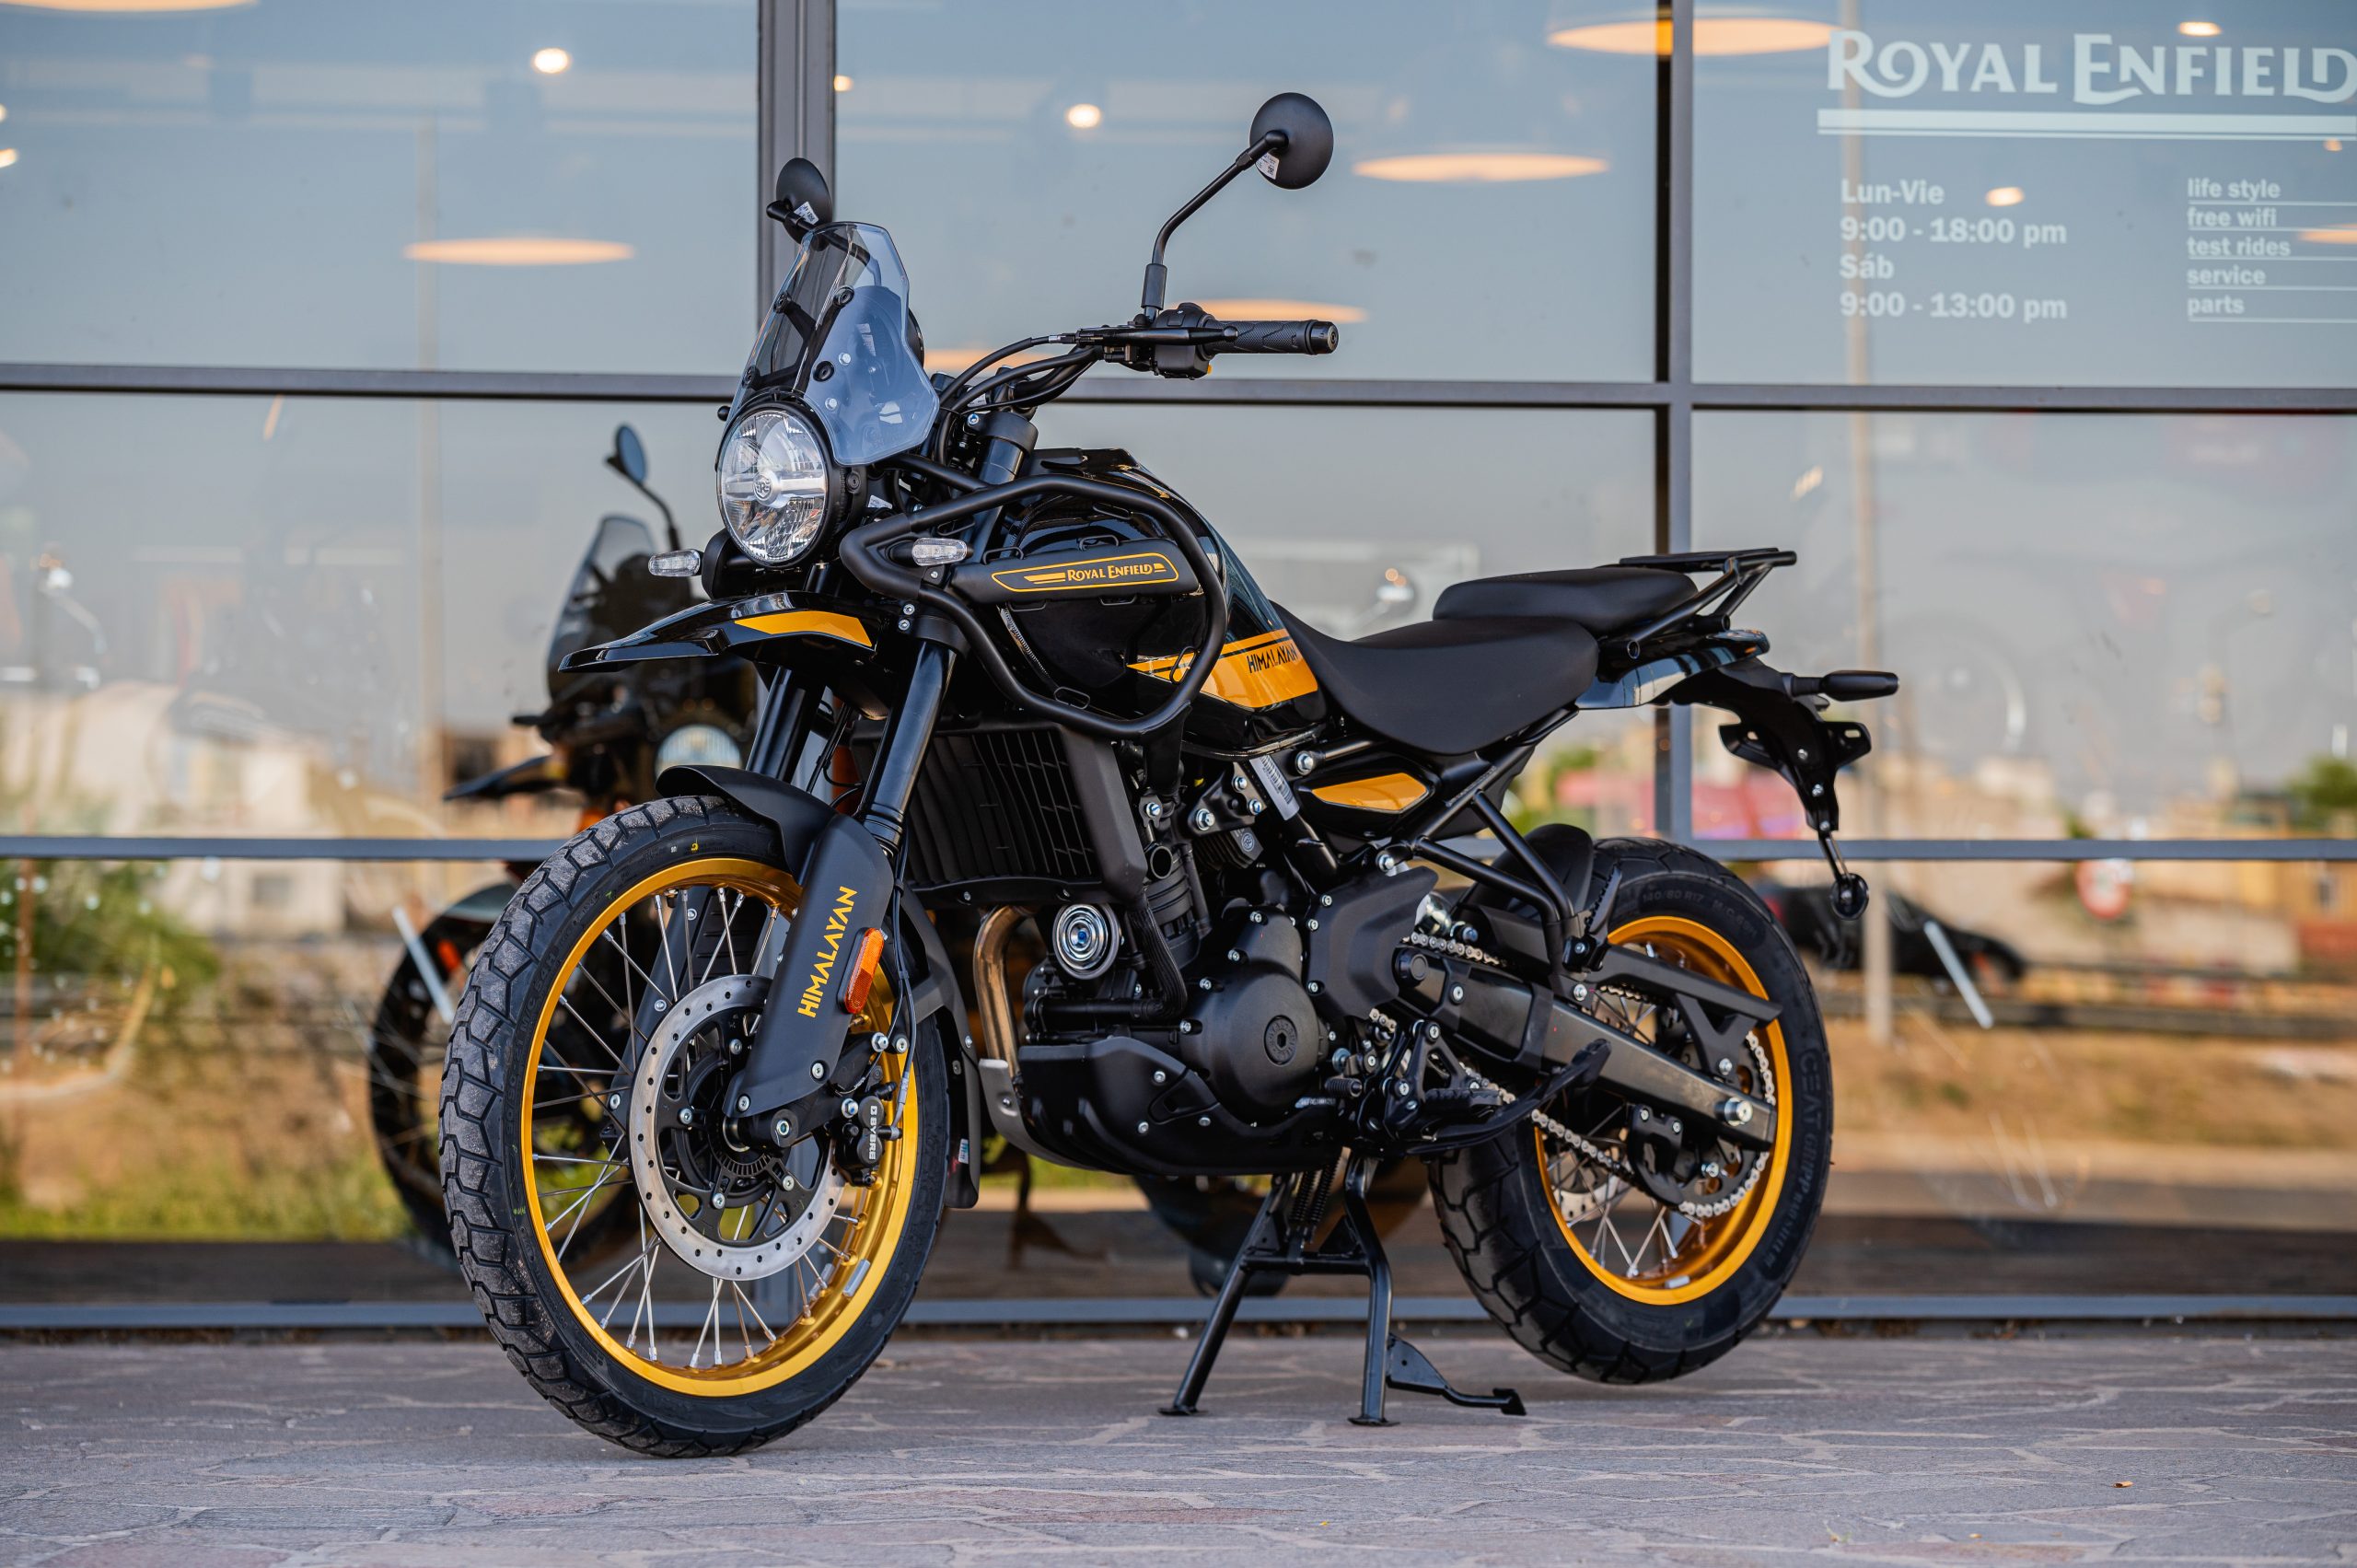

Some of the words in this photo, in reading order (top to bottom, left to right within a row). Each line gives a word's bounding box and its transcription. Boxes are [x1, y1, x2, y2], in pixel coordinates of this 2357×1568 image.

[1828, 29, 2058, 98] ROYAL
[2073, 33, 2357, 104] ENFIELD
[1840, 179, 1945, 205] Lun-Vie
[2187, 179, 2222, 199] life
[2227, 179, 2281, 202] style
[2187, 207, 2231, 227] free
[2236, 207, 2277, 227] wifi
[1840, 217, 1905, 242] 9:00
[1930, 218, 2014, 243] 18:00
[2024, 223, 2067, 249] pm
[2187, 237, 2230, 257] test
[2236, 237, 2292, 257] rides
[1840, 251, 1894, 279] Sáb
[2187, 266, 2266, 285] service
[1840, 292, 1905, 317] 9:00
[1930, 293, 2014, 319] 13:00
[2024, 297, 2067, 323] pm
[2187, 295, 2245, 317] parts
[1066, 567, 1106, 582] ROYAL
[1107, 563, 1154, 580] ENFIELD
[1246, 643, 1298, 674] HIMALAYAN
[797, 886, 858, 1018] HIMALAYAN
